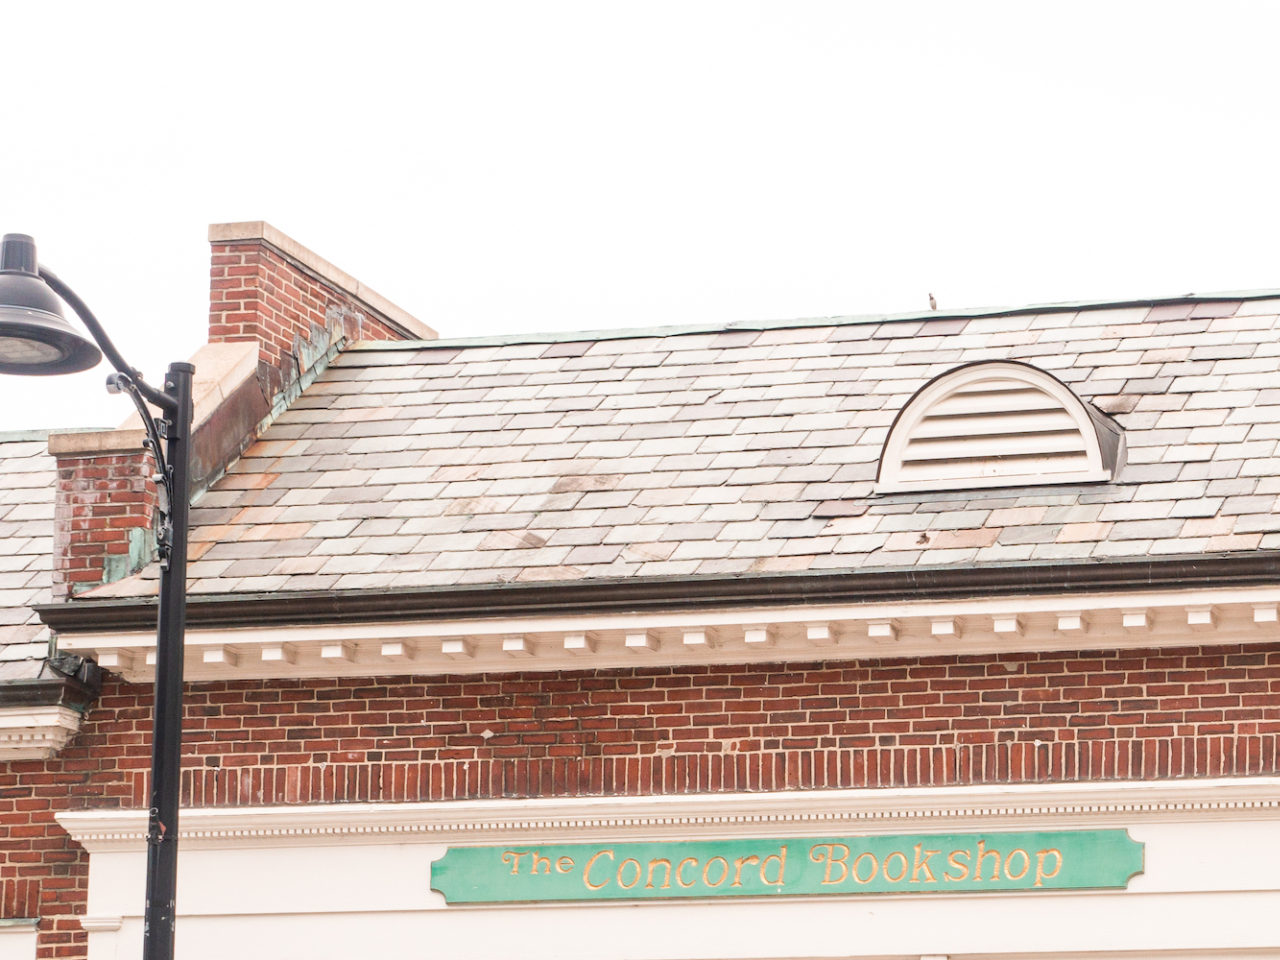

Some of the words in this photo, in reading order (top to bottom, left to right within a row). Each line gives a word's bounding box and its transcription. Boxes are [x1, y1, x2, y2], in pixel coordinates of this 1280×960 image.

[501, 849, 576, 875] The
[583, 844, 788, 891] Concord
[809, 839, 1063, 888] Bookshop
